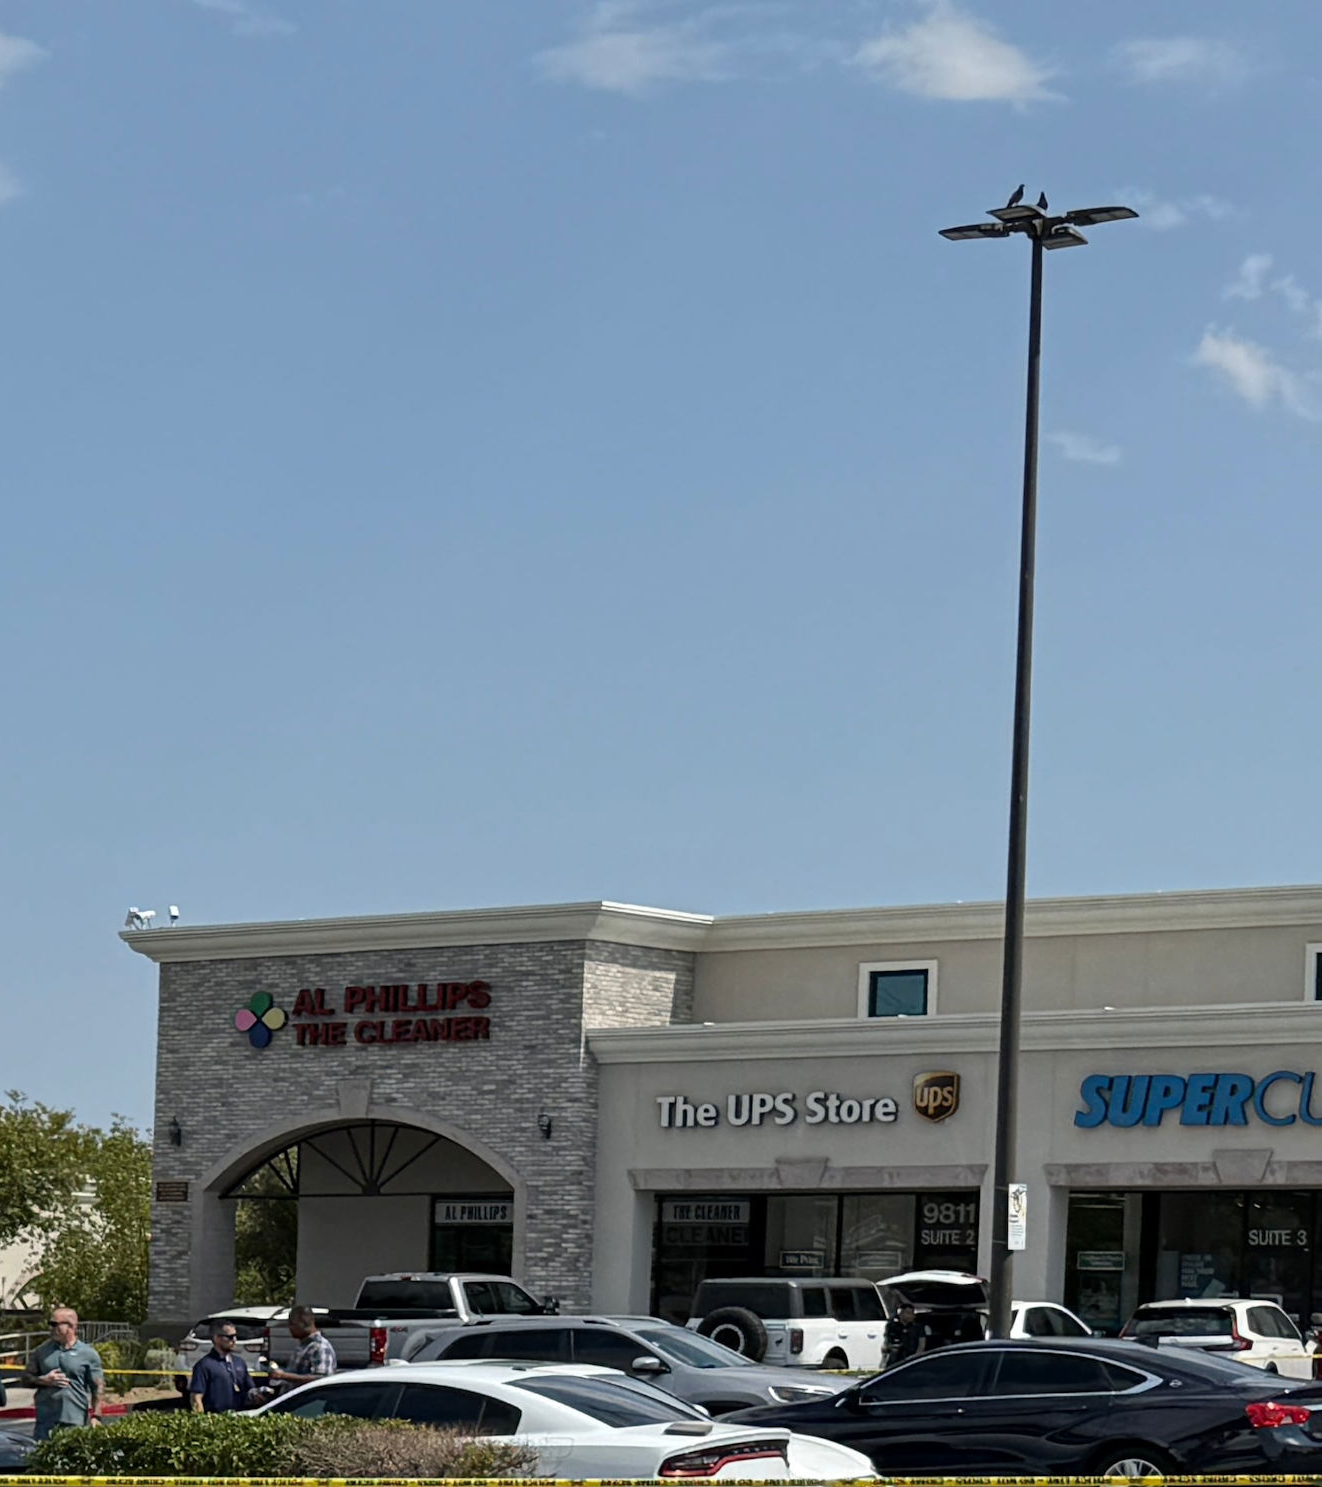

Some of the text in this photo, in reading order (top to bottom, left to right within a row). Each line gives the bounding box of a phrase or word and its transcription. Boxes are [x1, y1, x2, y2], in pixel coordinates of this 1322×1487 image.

[292, 980, 492, 1016] AL PHILLIPS
[292, 1016, 491, 1046] THE CLEANER
[656, 1091, 898, 1128] The UPS Store
[445, 1205, 507, 1220] AL PHILLIPS
[673, 1204, 740, 1219] THE CLEANER
[924, 1203, 975, 1224] 9811
[921, 1230, 975, 1245] SUITE 2
[1248, 1229, 1307, 1245] SUITE 3
